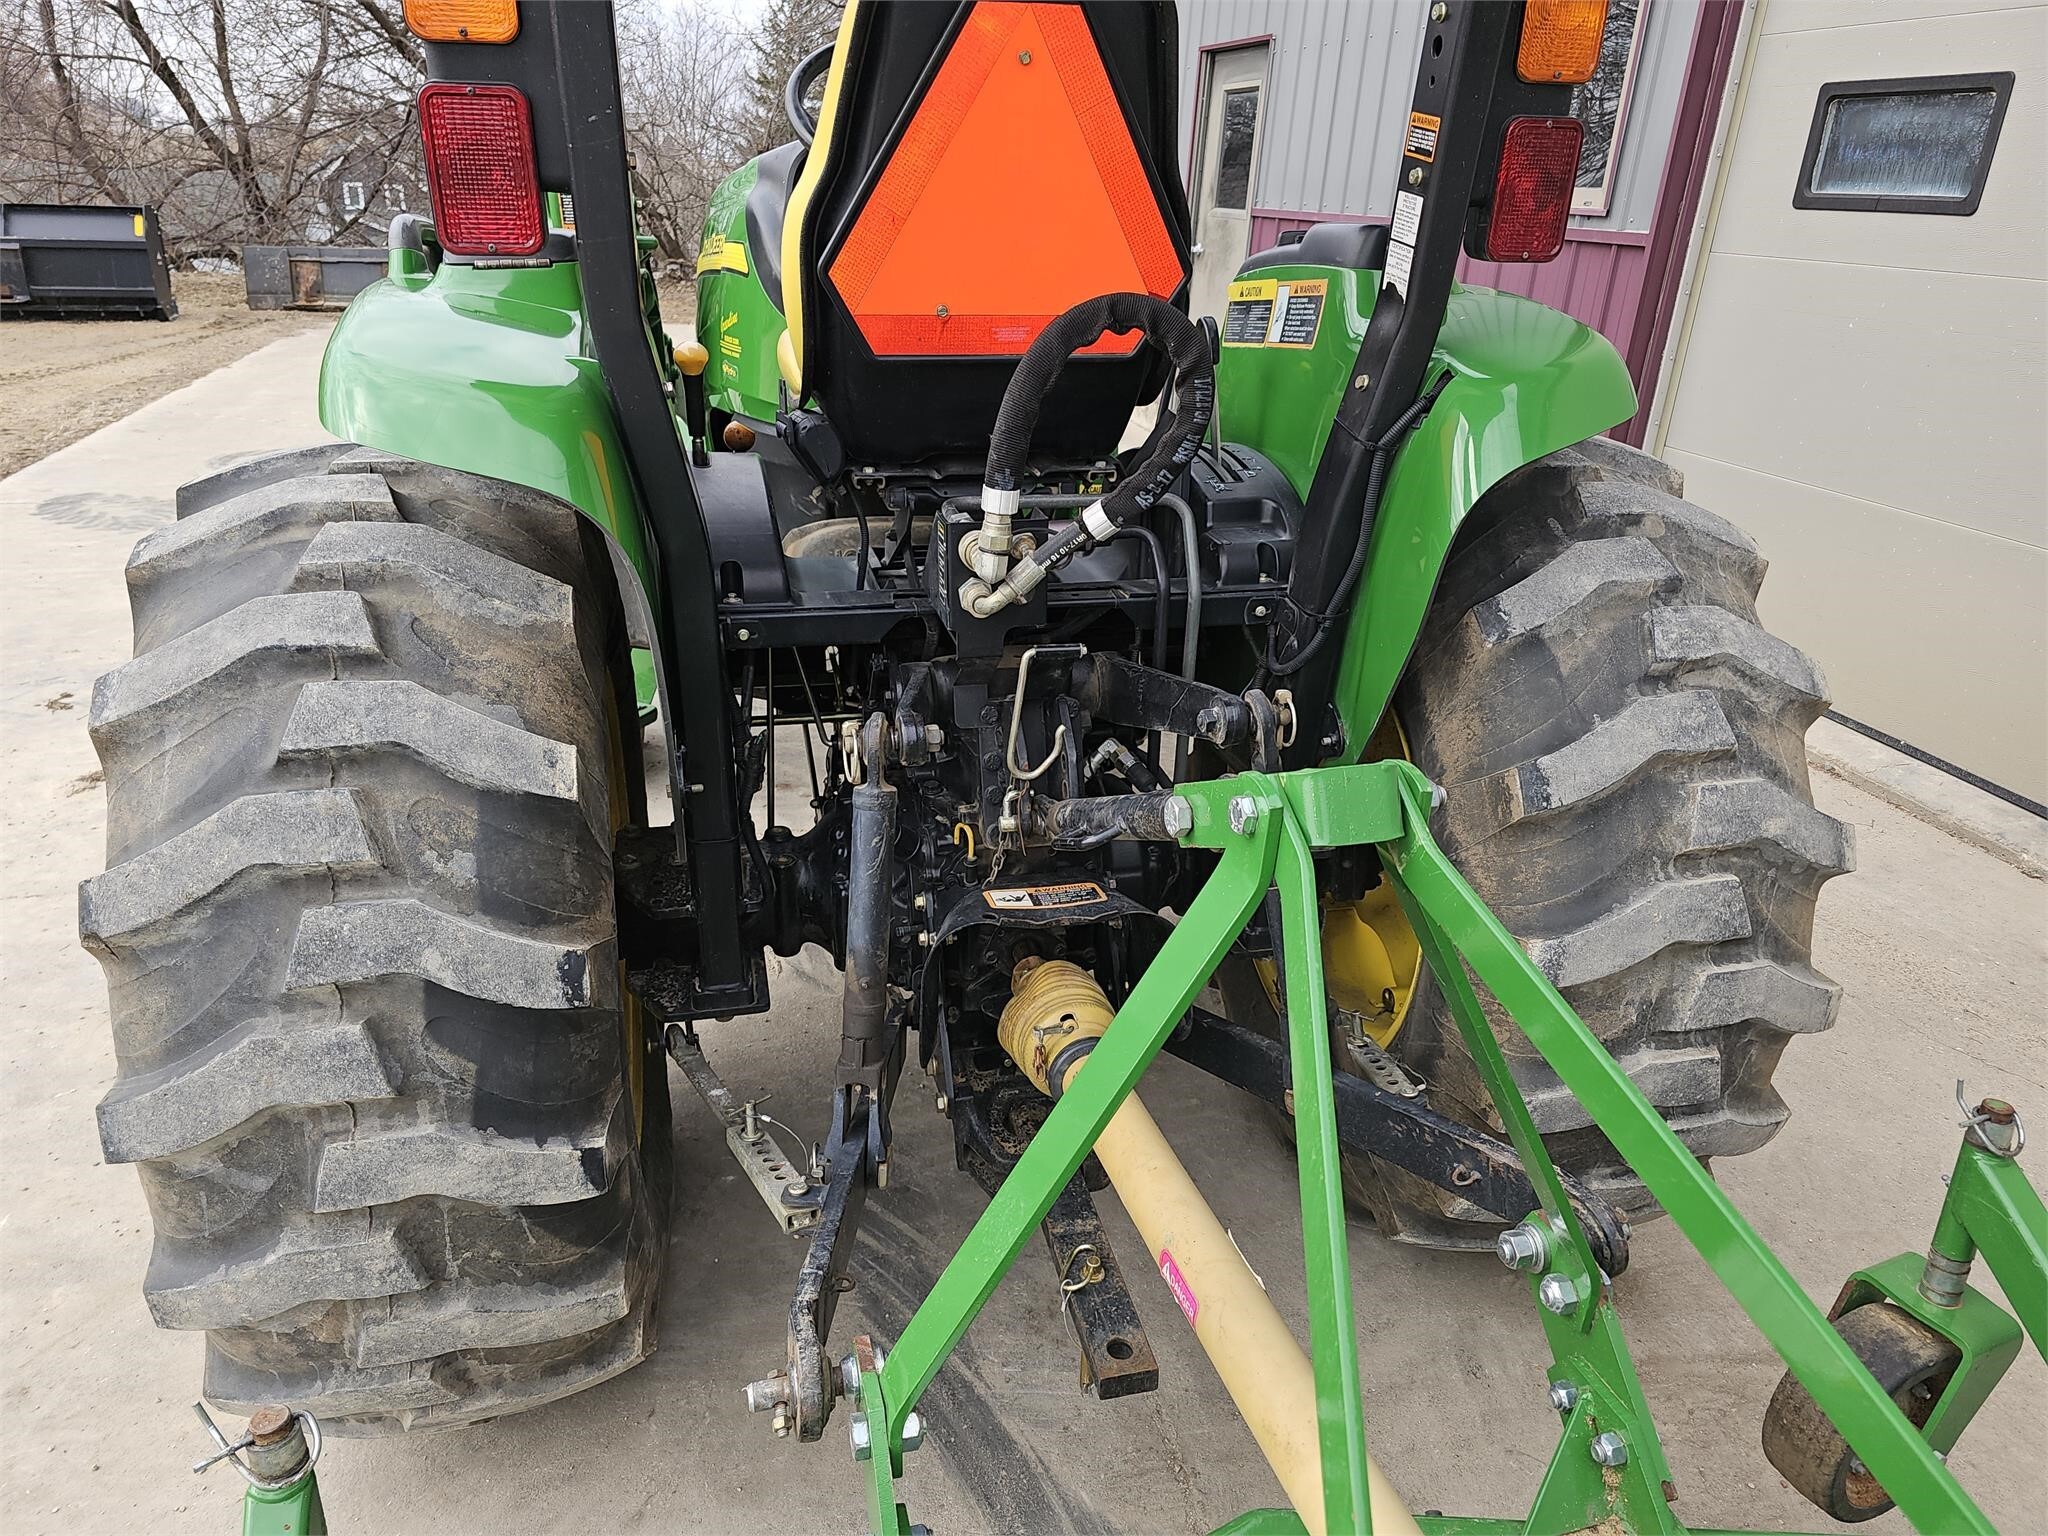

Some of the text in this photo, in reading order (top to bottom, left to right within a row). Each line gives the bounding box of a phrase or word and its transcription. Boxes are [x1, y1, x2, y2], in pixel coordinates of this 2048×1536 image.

[1244, 286, 1262, 297] CAUTION
[1299, 284, 1321, 294] WARNING
[1042, 884, 1088, 892] WARNING
[1170, 1274, 1194, 1317] DANGER
